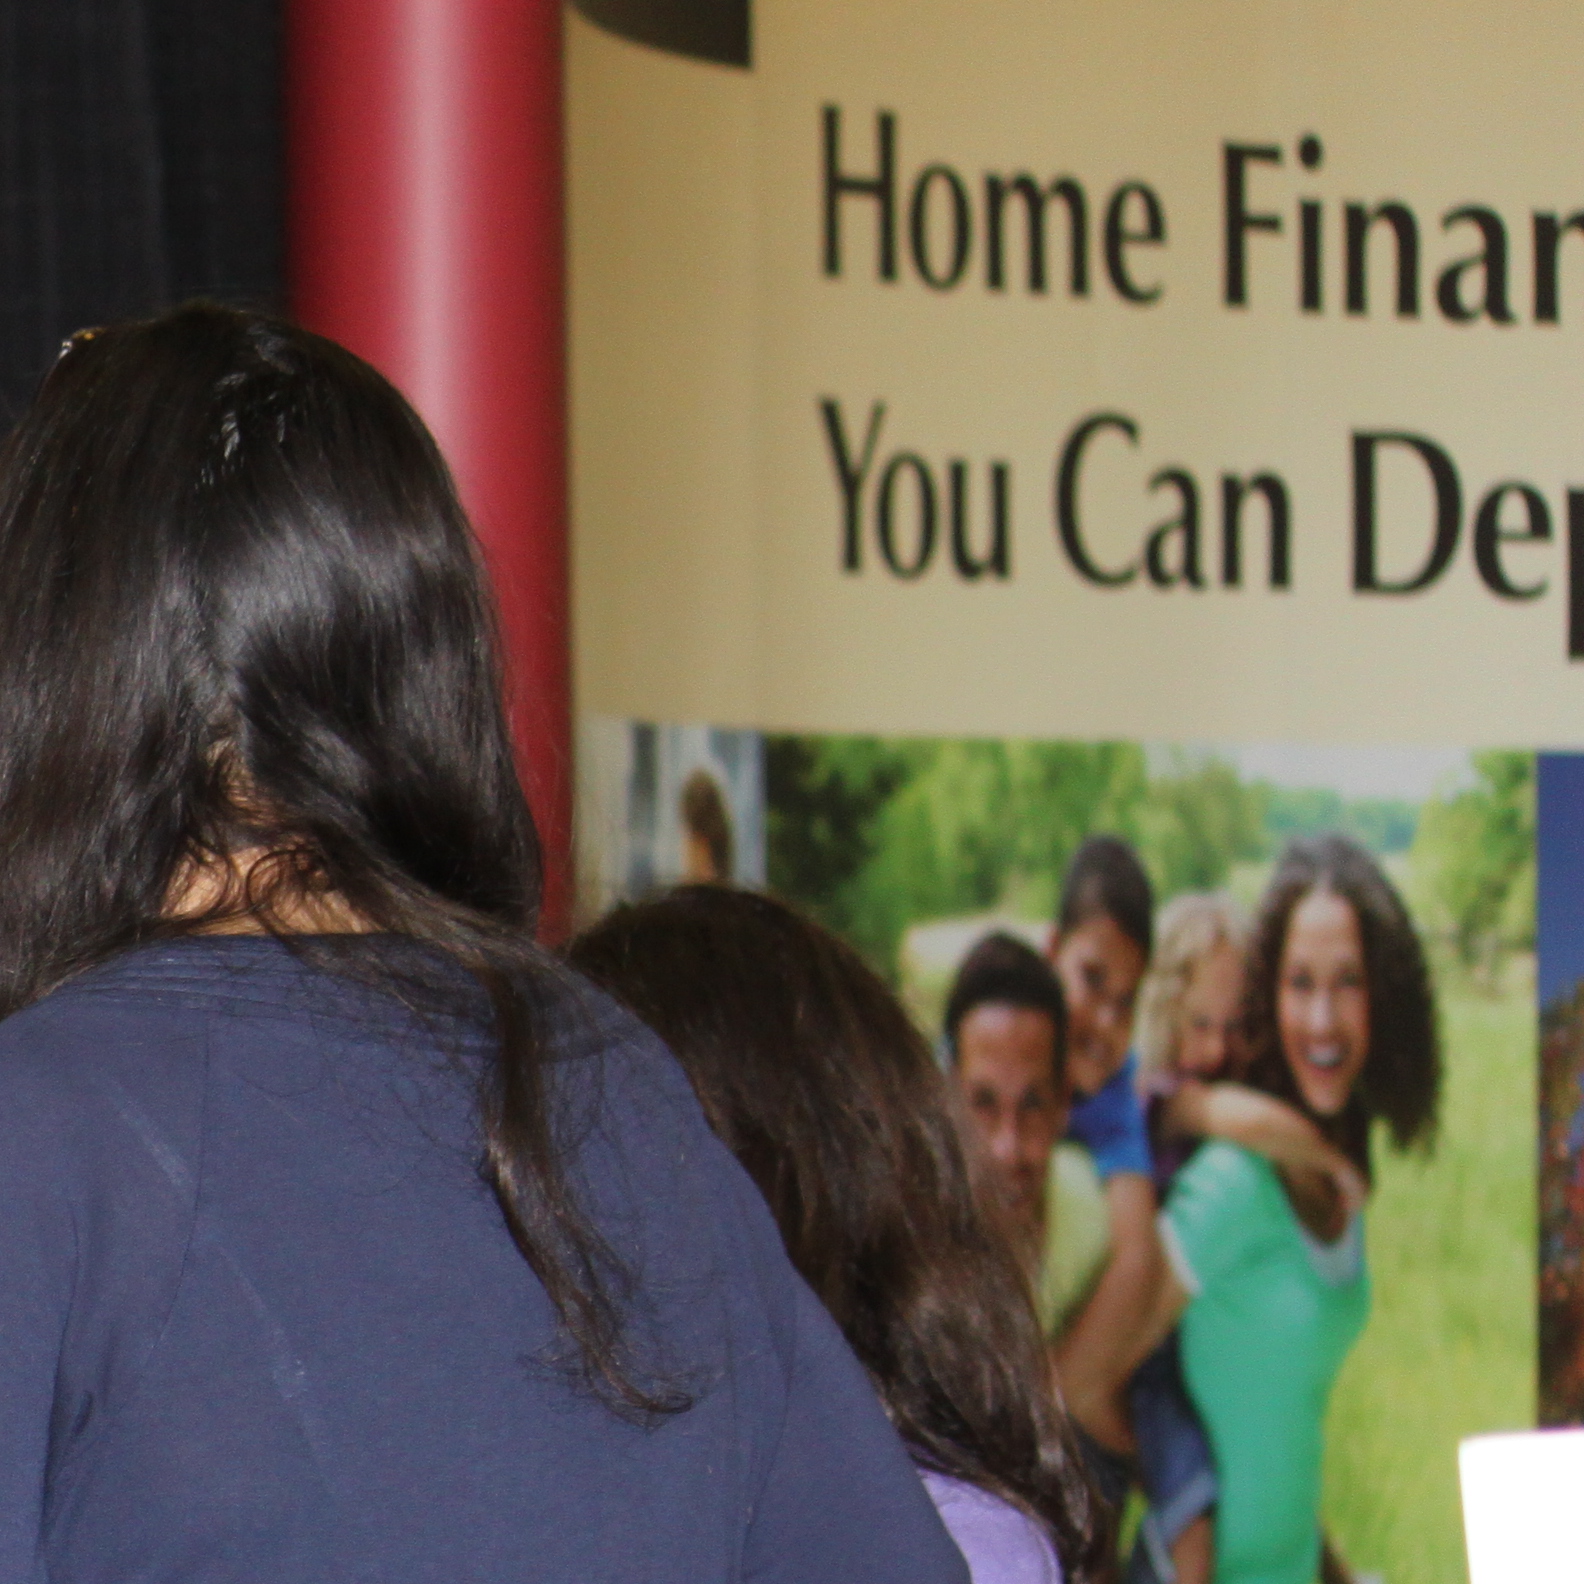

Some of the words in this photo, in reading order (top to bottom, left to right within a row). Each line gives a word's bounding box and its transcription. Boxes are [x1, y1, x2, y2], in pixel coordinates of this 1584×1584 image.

[821, 103, 1166, 306] Home
[818, 397, 1010, 582] You
[1055, 411, 1291, 590] Can
[1351, 429, 1584, 661] De
